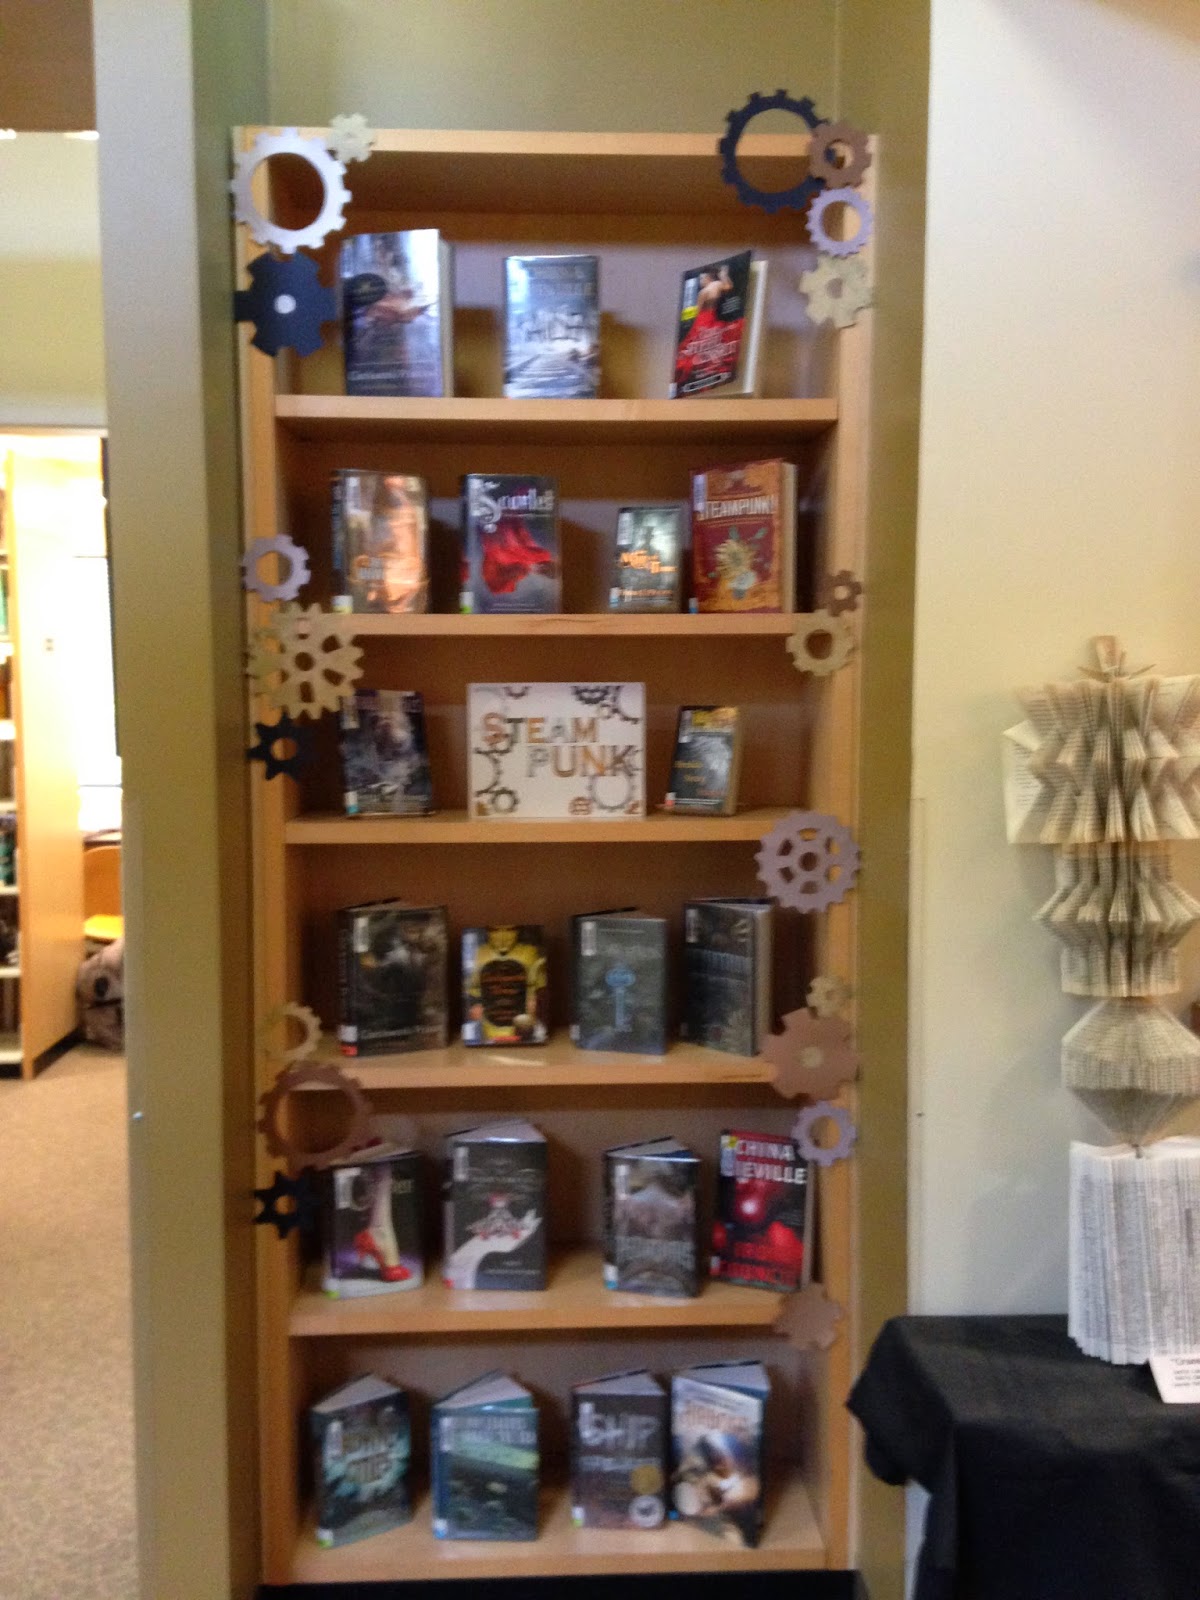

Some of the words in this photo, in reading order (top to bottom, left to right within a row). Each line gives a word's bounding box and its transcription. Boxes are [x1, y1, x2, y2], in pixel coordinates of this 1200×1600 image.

[482, 711, 600, 745] STEAM
[526, 745, 636, 777] PUNK
[736, 1139, 796, 1161] CHINA
